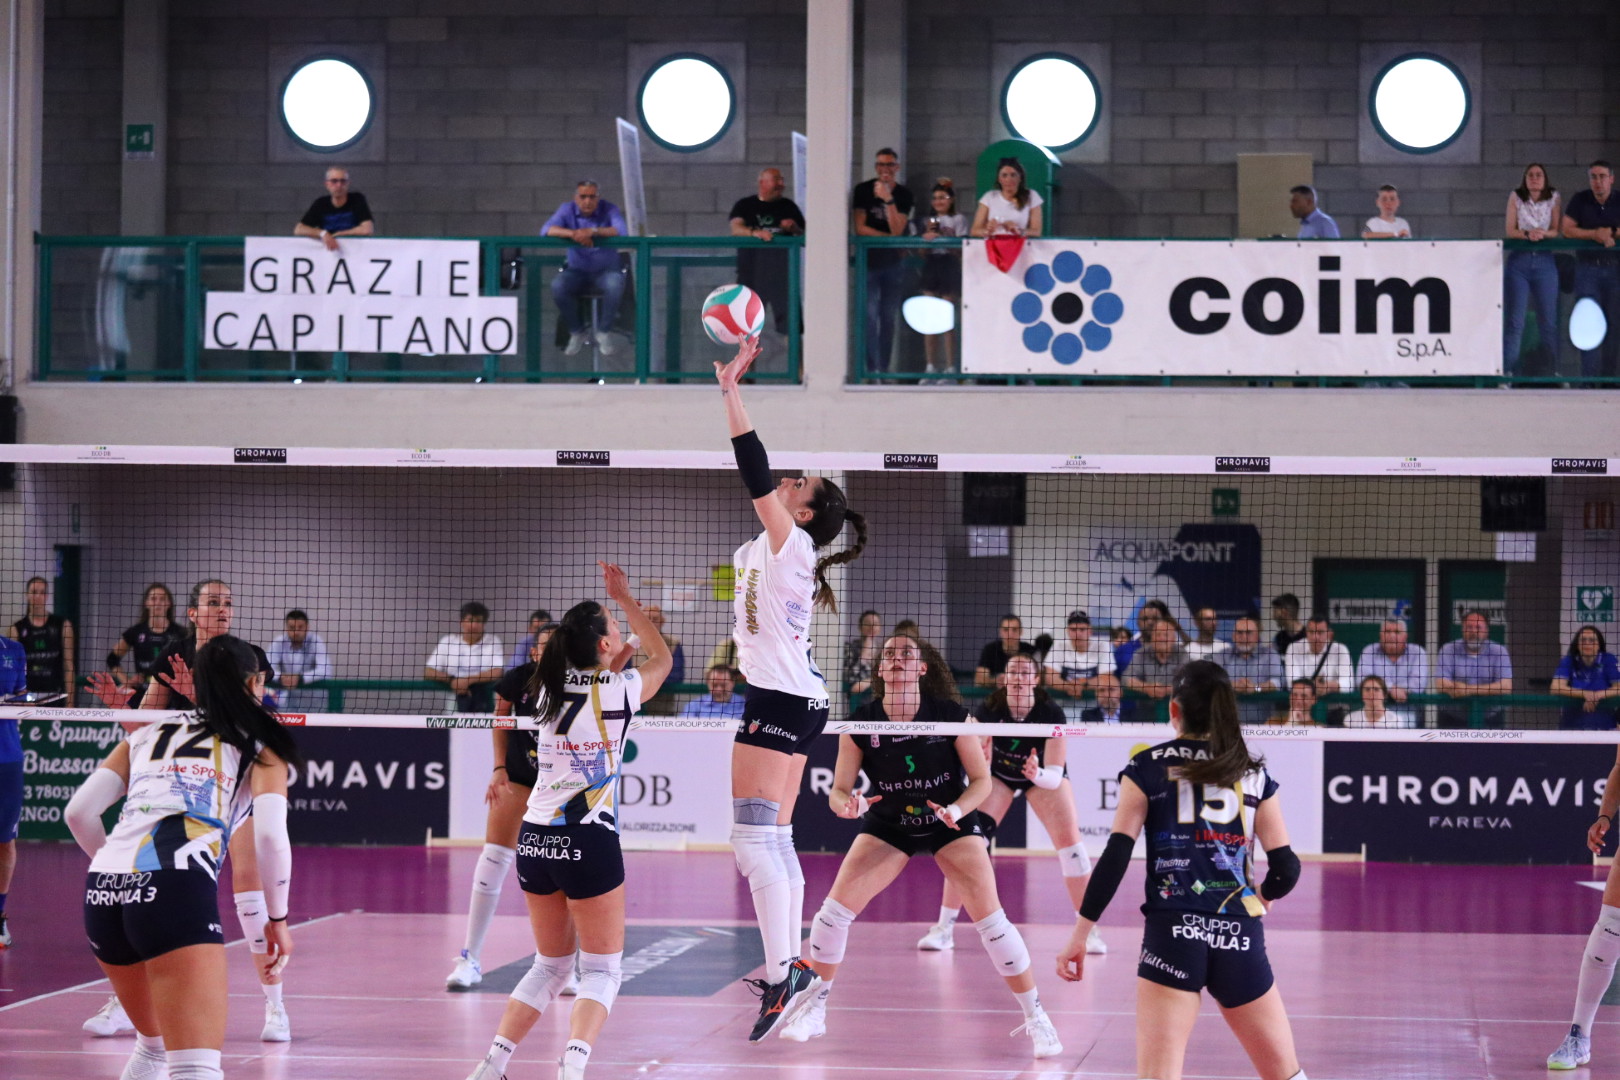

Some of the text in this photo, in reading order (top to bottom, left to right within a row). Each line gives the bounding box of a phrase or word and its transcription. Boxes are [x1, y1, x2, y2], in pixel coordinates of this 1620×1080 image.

[249, 256, 470, 297] GRAZIE
[1169, 256, 1450, 335] coim
[212, 312, 513, 354] CAPITANO
[1396, 338, 1451, 361] S.p.A.
[235, 449, 286, 457] CHROMAVIS
[557, 452, 609, 460] CHROMAVIS
[885, 455, 937, 463] CHROMAVIS
[1216, 458, 1270, 466] CHROMAVIS
[1553, 459, 1606, 468] CHROMAVIS
[1094, 541, 1235, 563] ACQUAPOINT
[554, 692, 589, 736] 7
[455, 719, 491, 728] MAMMA
[148, 722, 217, 761] 12
[1439, 731, 1523, 739] MASTER GROUP SPORT
[1151, 746, 1214, 760] FARA
[22, 749, 103, 774] Bressa
[904, 755, 916, 773] 5
[878, 772, 950, 792] CHROMAVIS
[35, 785, 80, 800] 78031
[1167, 765, 1239, 824] 15
[620, 822, 697, 833] ALORIZZAZIONE
[1429, 816, 1512, 829] FAREVA
[522, 832, 571, 848] GRUPPO
[572, 849, 582, 861] 3
[96, 872, 153, 889] GRUPPO
[143, 886, 158, 902] 3
[1182, 913, 1242, 936] GRUPPO
[1240, 936, 1251, 952] 3
